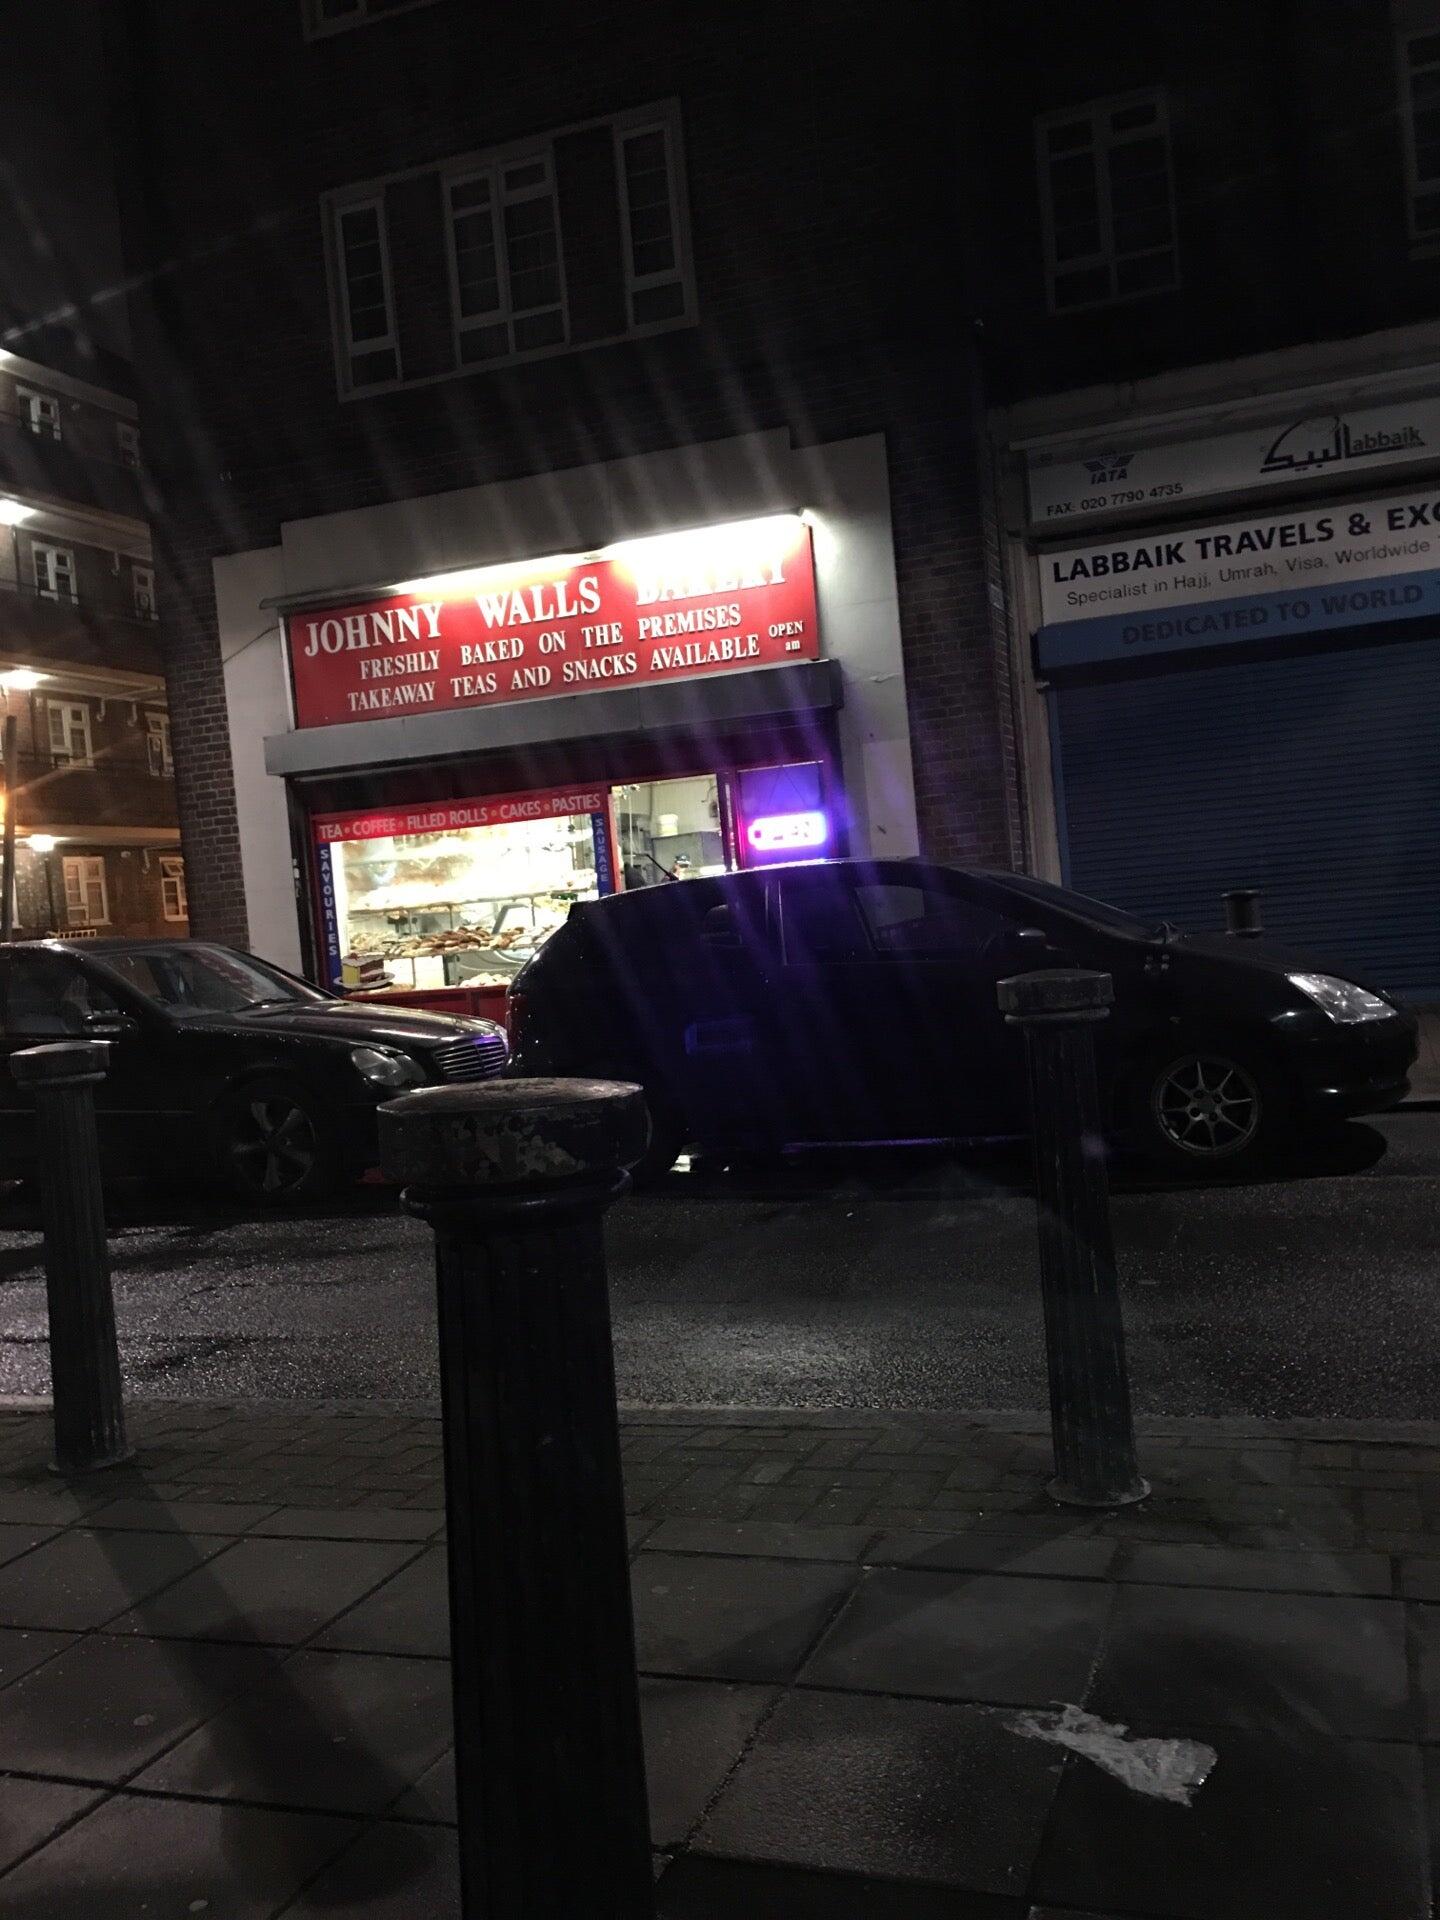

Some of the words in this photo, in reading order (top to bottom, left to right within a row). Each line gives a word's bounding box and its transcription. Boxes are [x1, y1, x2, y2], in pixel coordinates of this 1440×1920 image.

[1047, 501, 1074, 516] FAX:
[1081, 494, 1108, 512] 020
[1111, 488, 1145, 505] 7790
[1149, 482, 1183, 498] 4735
[1091, 468, 1128, 484] IATA
[1053, 541, 1186, 583] LABBAIK
[1196, 518, 1335, 560] TRAVELS
[1348, 512, 1371, 535] &
[1066, 581, 1147, 607] Specialist
[1153, 579, 1169, 593] in
[1173, 573, 1212, 593] Hajj,
[1219, 561, 1279, 584] Umrah,
[1285, 555, 1329, 573] Visa,
[1335, 538, 1431, 564] Worldwide
[304, 601, 443, 658] JOHNNY
[476, 575, 601, 627] WALLS
[360, 648, 441, 681] FRESHLY
[460, 635, 525, 668] BAKED
[538, 630, 567, 655] ON
[581, 622, 624, 649] THE
[637, 602, 743, 642] PREMISES
[768, 620, 804, 639] OPEN
[784, 640, 802, 652] am
[1121, 606, 1268, 645] DEDICATED
[1276, 599, 1312, 622] TO
[1320, 583, 1423, 616] WORLD
[347, 680, 436, 713] TAKEAWAY
[450, 672, 498, 700] TEAS
[510, 664, 552, 691] AND
[562, 652, 638, 686] SNACKS
[649, 633, 760, 672] AVAILABLE
[319, 823, 343, 840] TEA
[352, 816, 397, 836] COFFEE
[406, 811, 447, 830] FILLED
[449, 806, 488, 826] ROLLS
[499, 799, 541, 819] CAKES
[552, 792, 601, 814] PASTIES
[594, 818, 609, 882] SAUSAGE
[320, 849, 338, 956] SAVOURIES
